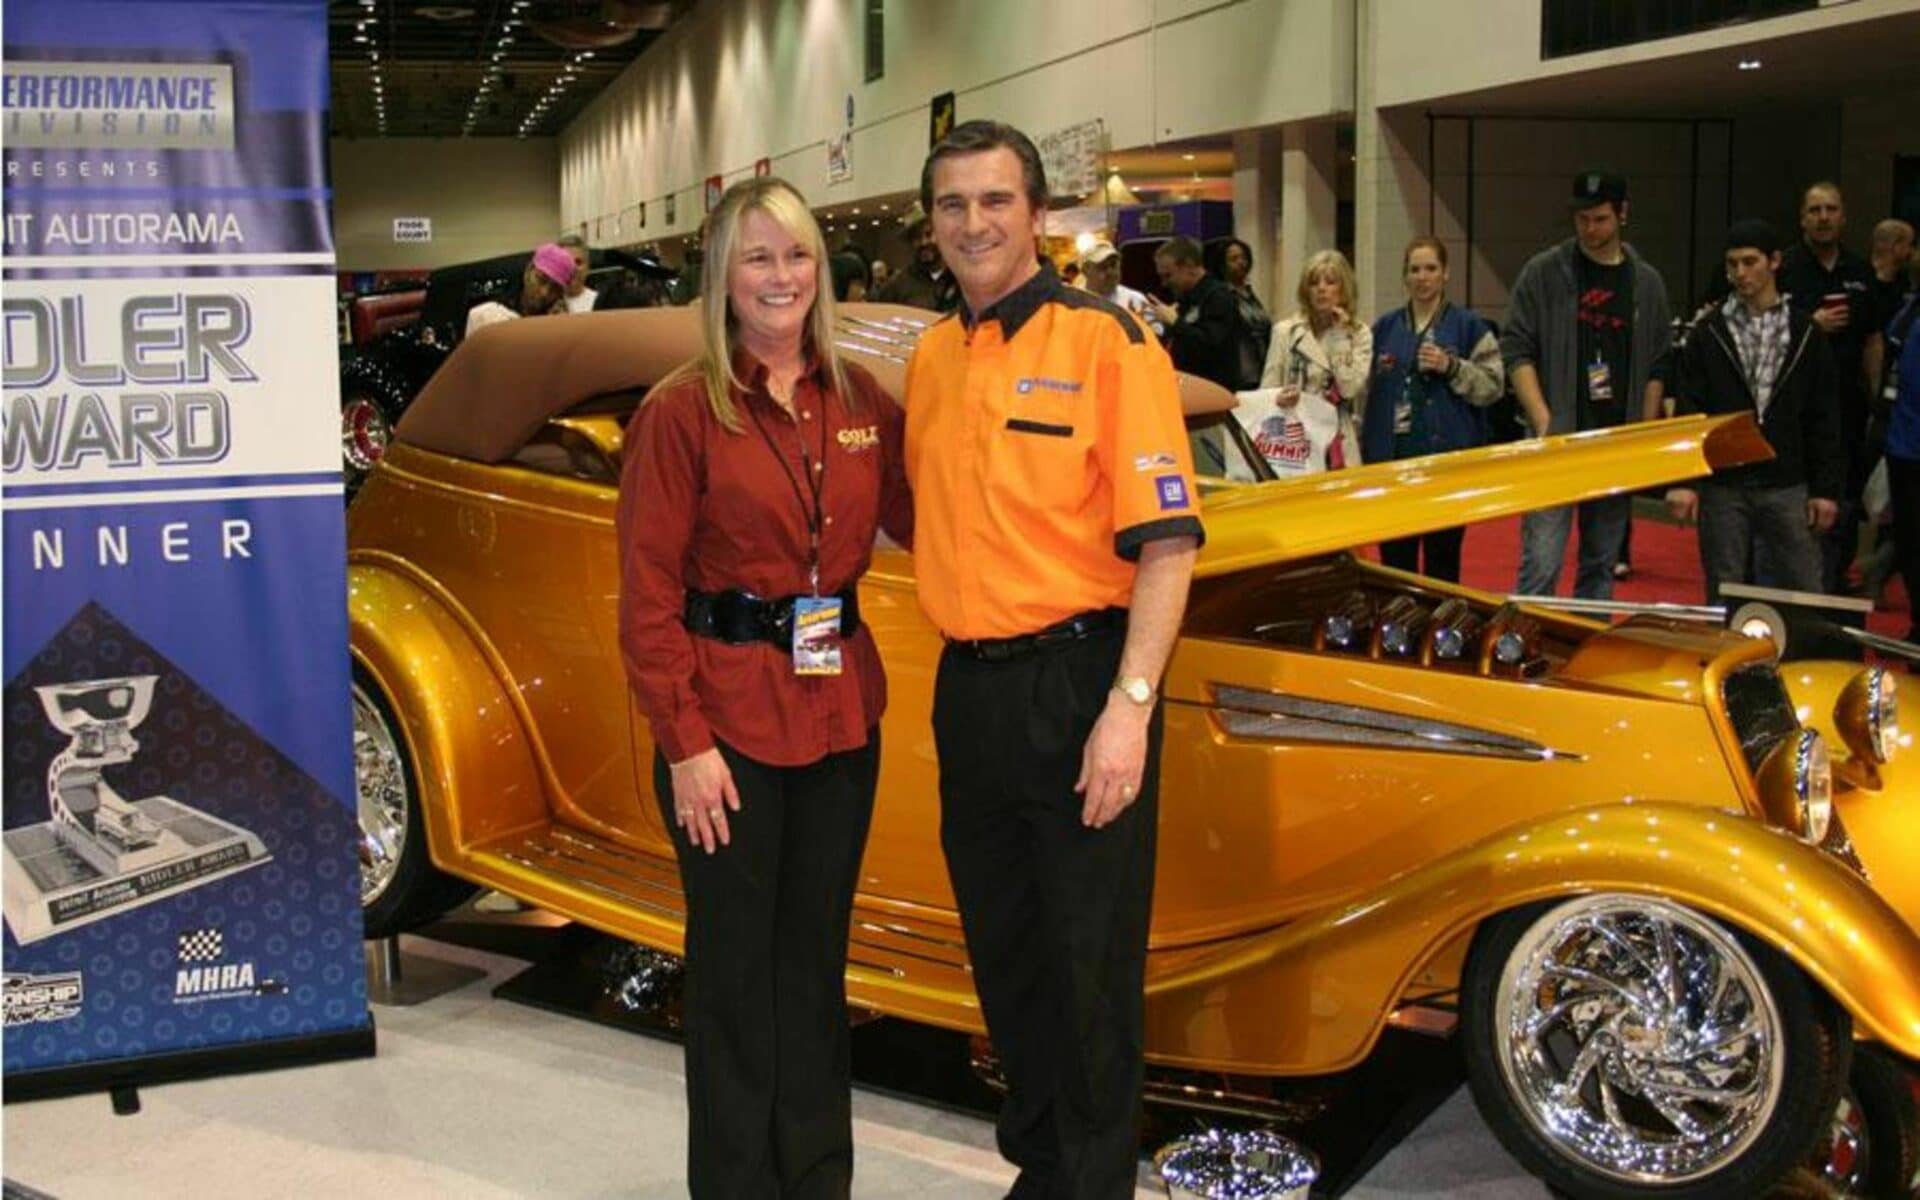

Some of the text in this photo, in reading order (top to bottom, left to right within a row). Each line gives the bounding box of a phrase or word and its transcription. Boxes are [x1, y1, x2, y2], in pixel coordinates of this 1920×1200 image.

[7, 161, 160, 177] RESENTS
[45, 213, 244, 245] AUTORAMA
[3, 294, 259, 389] DLER
[33, 519, 251, 569] NNER
[176, 963, 255, 995] MHRA
